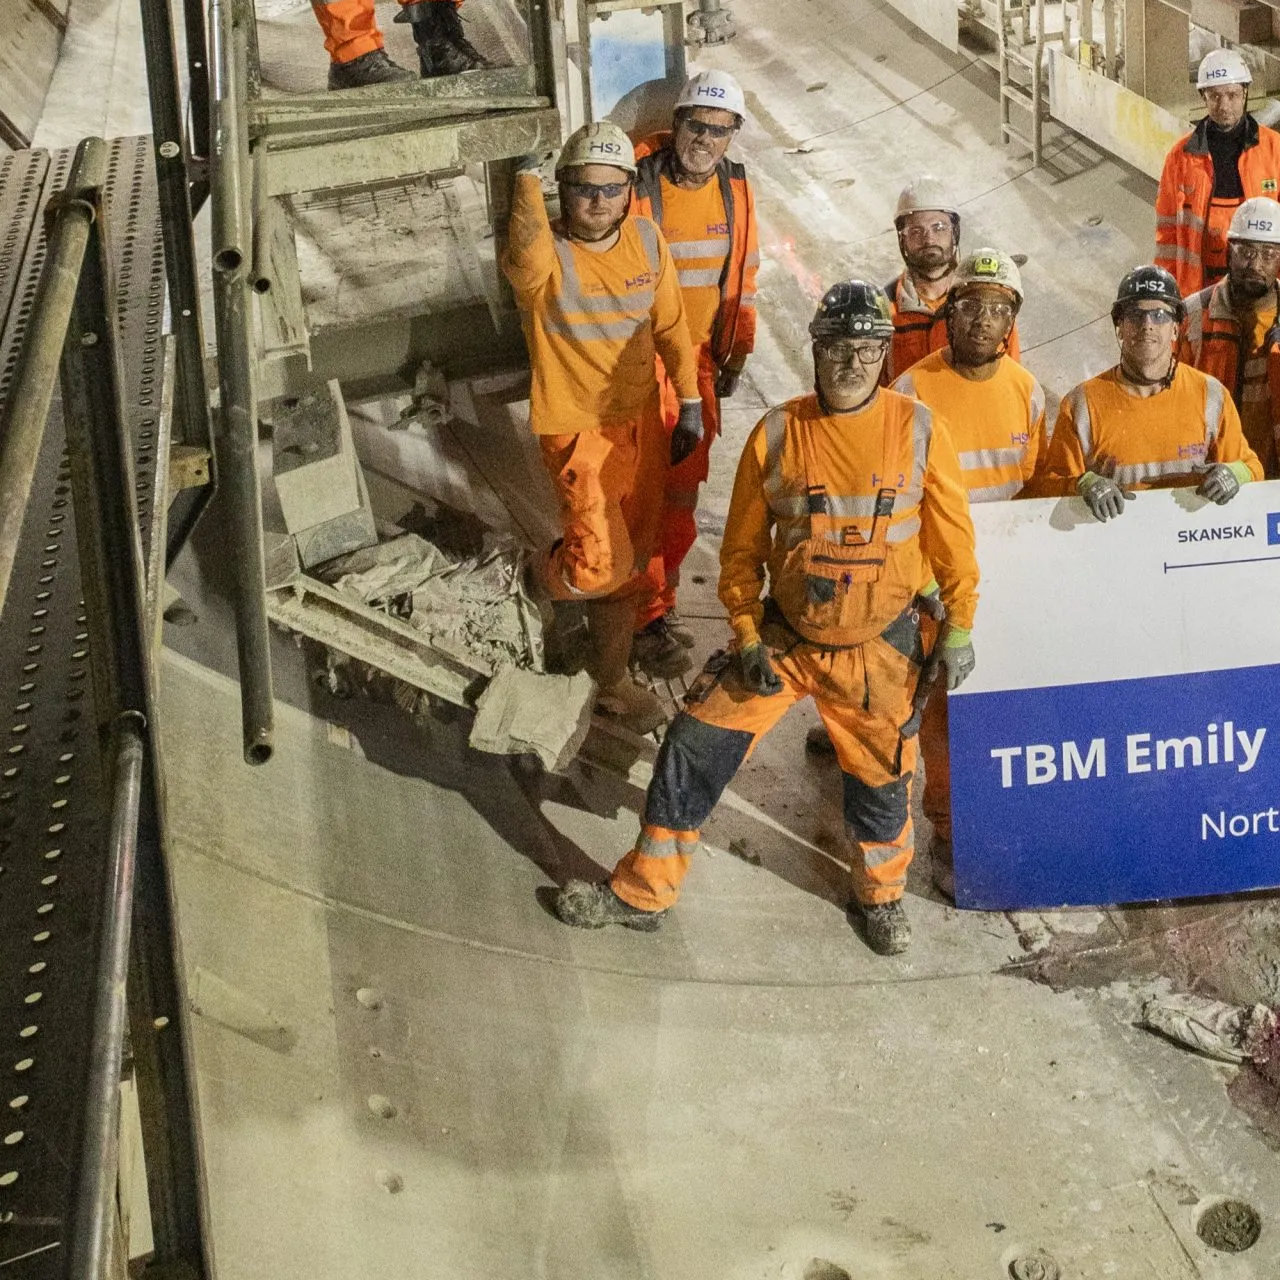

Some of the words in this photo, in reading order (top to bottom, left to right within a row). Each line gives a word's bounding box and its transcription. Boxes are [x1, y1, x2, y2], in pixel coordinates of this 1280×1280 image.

[1206, 69, 1228, 80] HS2
[697, 86, 726, 99] HS2
[590, 141, 622, 156] HS2
[1247, 220, 1273, 232] HS2
[624, 272, 652, 289] HS2
[1135, 280, 1165, 293] HS2
[1177, 443, 1206, 457] HS2
[871, 472, 905, 488] H2
[1177, 524, 1255, 543] SKANSKA
[991, 738, 1106, 788] TBM
[1126, 721, 1266, 774] Emily
